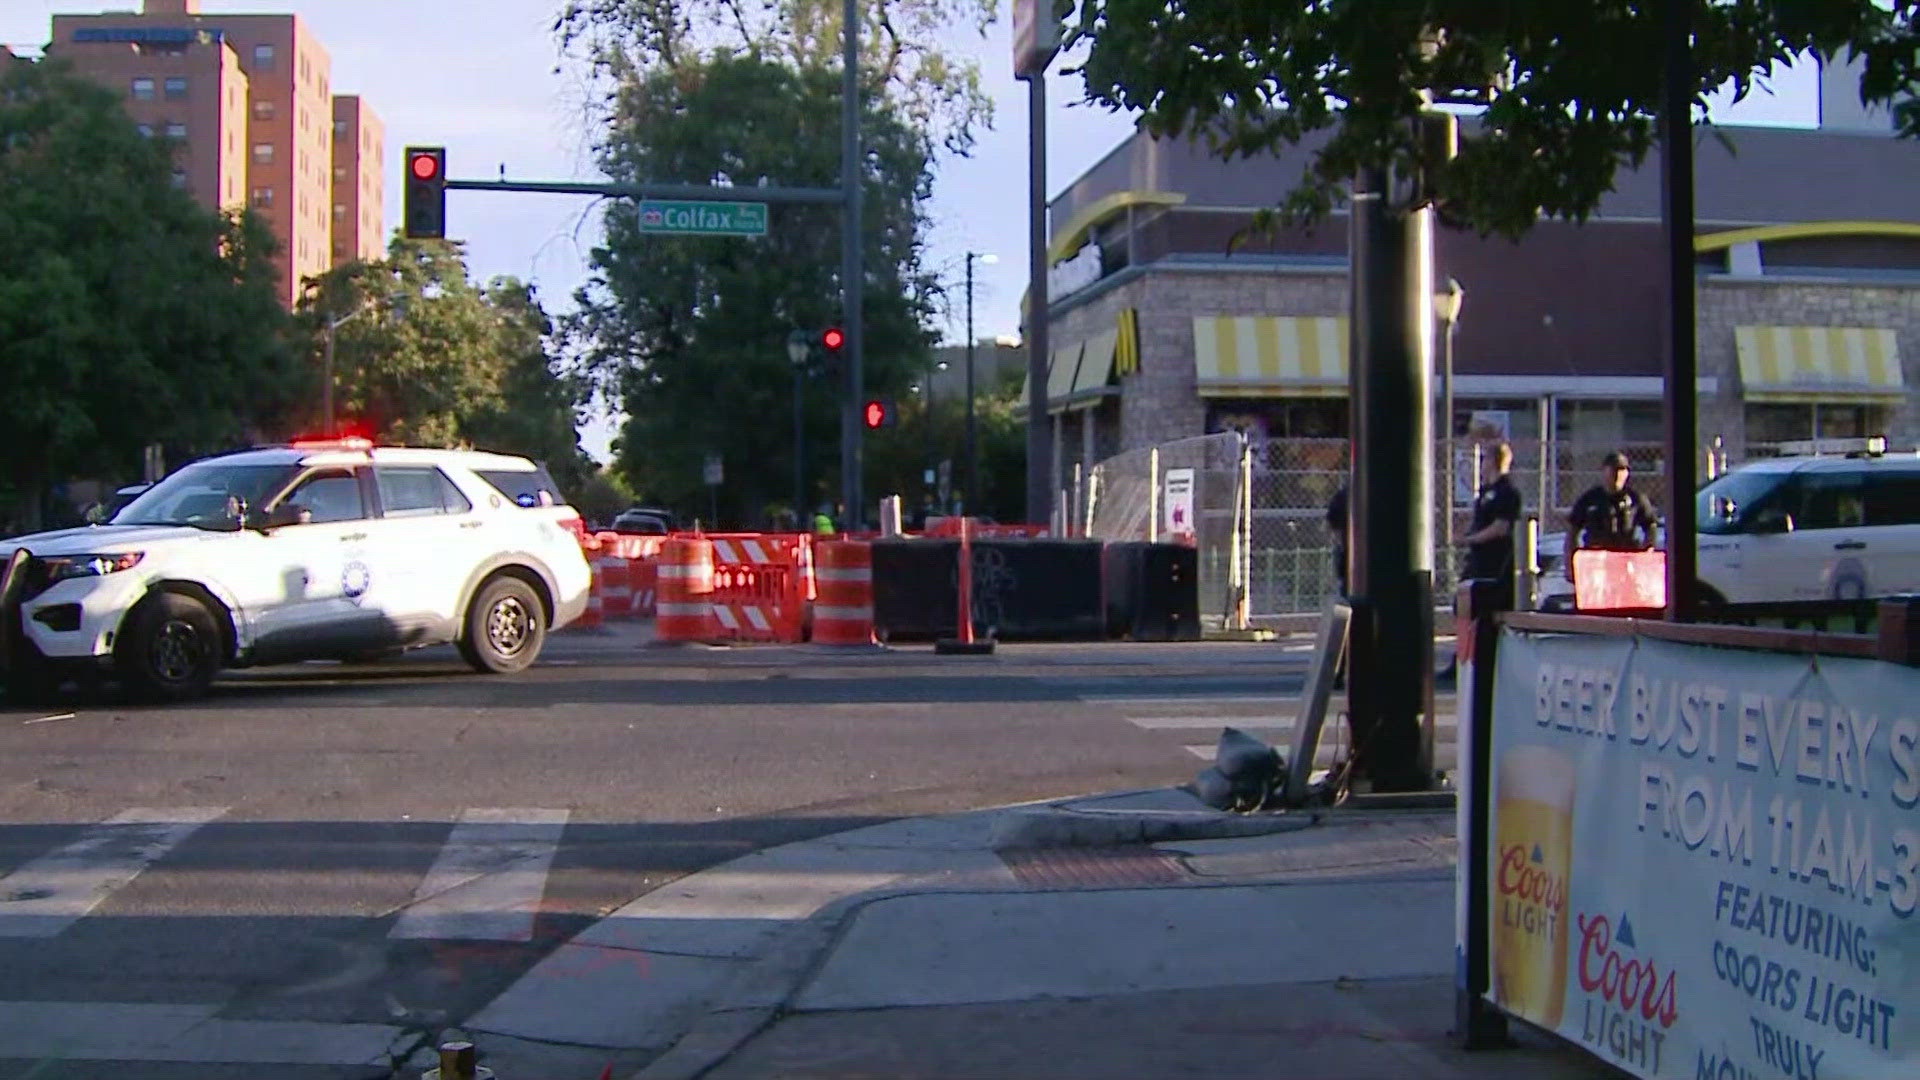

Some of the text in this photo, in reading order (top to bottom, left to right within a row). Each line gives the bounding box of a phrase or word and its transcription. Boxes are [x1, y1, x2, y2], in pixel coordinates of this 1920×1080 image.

[664, 206, 732, 229] Colfax
[1536, 662, 1617, 741] BEER
[1629, 672, 1729, 763] BUST
[1736, 692, 1879, 798] EVERY
[1638, 762, 1752, 866] FROM
[1499, 844, 1564, 912] Coors
[1503, 901, 1557, 942] LIGHT
[1577, 911, 1678, 1029] Coors
[1715, 878, 1877, 978] FEATURING:
[1582, 999, 1666, 1076] LIGHT
[1713, 939, 1896, 1051] COORS LIGHT
[1750, 1015, 1825, 1080] TRULY
